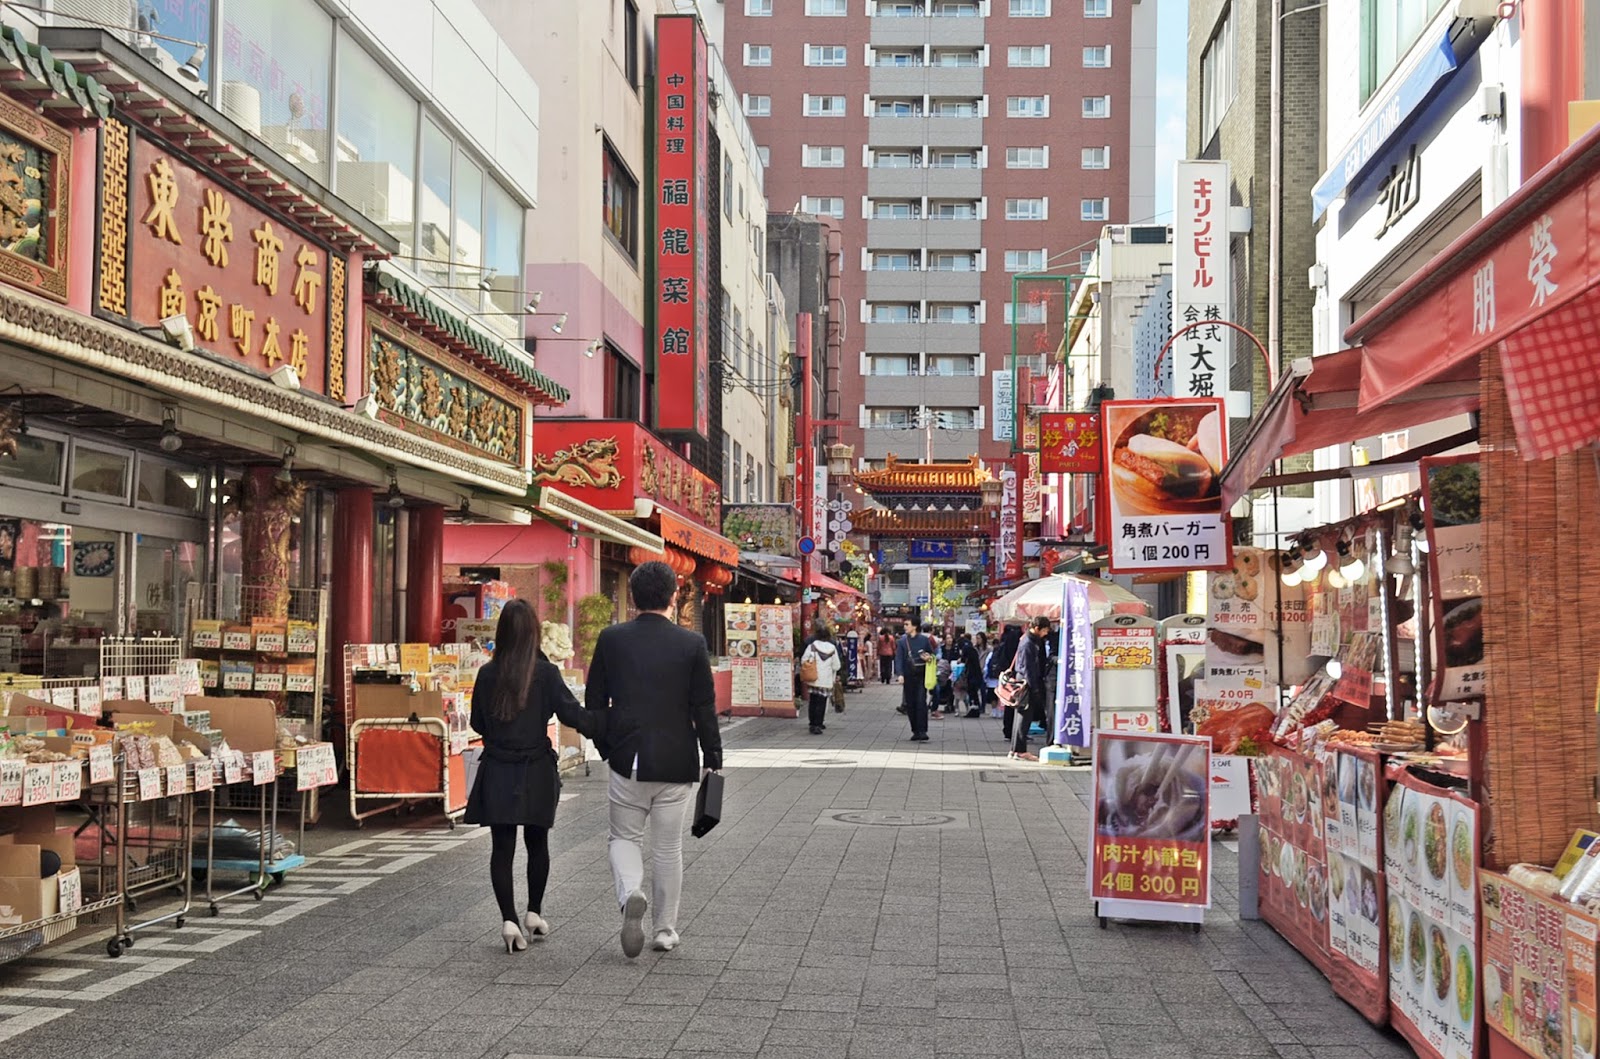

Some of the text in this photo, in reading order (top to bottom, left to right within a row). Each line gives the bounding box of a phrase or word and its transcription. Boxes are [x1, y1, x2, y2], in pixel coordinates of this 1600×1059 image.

[666, 73, 685, 153] 中国料理
[1362, 96, 1400, 162] BUILDING
[1193, 178, 1213, 288] キリンビール
[662, 179, 690, 354] 福龍菜館
[161, 268, 309, 379] 南京町本店
[1203, 304, 1222, 342] 株式
[1122, 521, 1216, 539] 角煮バーガー
[1211, 668, 1262, 676] 豚角煮バーガー
[1220, 690, 1253, 699] 200円
[1103, 843, 1199, 868] 肉汁小籠包
[1101, 872, 1200, 896] 4個300円
